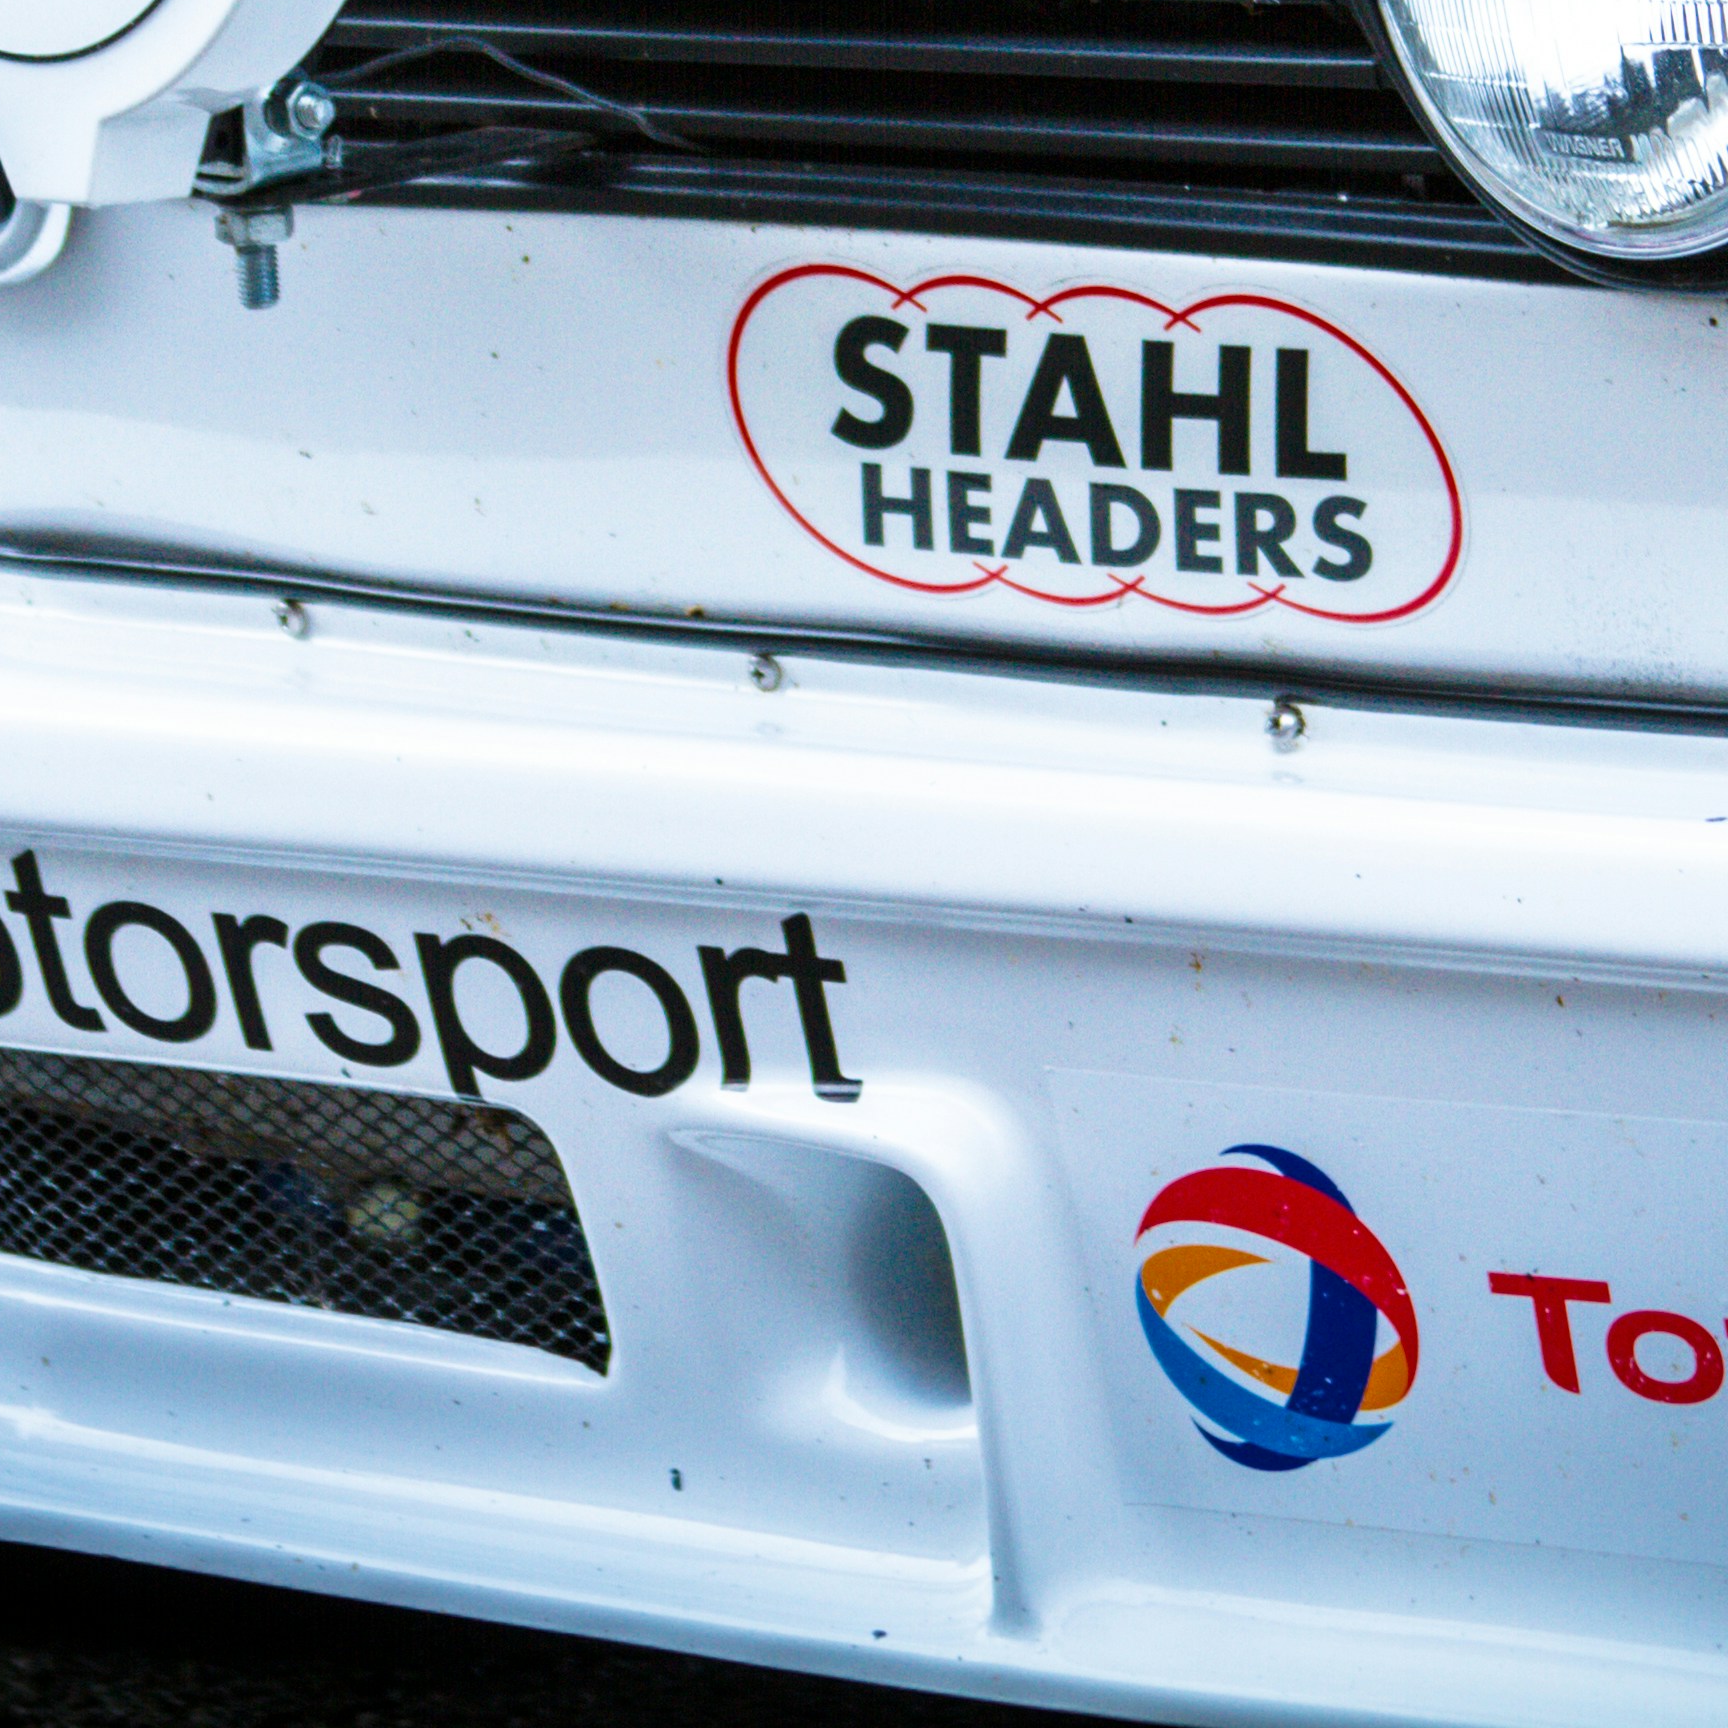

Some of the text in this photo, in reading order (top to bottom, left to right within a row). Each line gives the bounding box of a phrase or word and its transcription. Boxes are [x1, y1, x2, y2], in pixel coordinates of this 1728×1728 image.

[1545, 132, 1625, 159] WAGNER
[829, 314, 1349, 482] STAHL
[860, 461, 1374, 583] HEADERS
